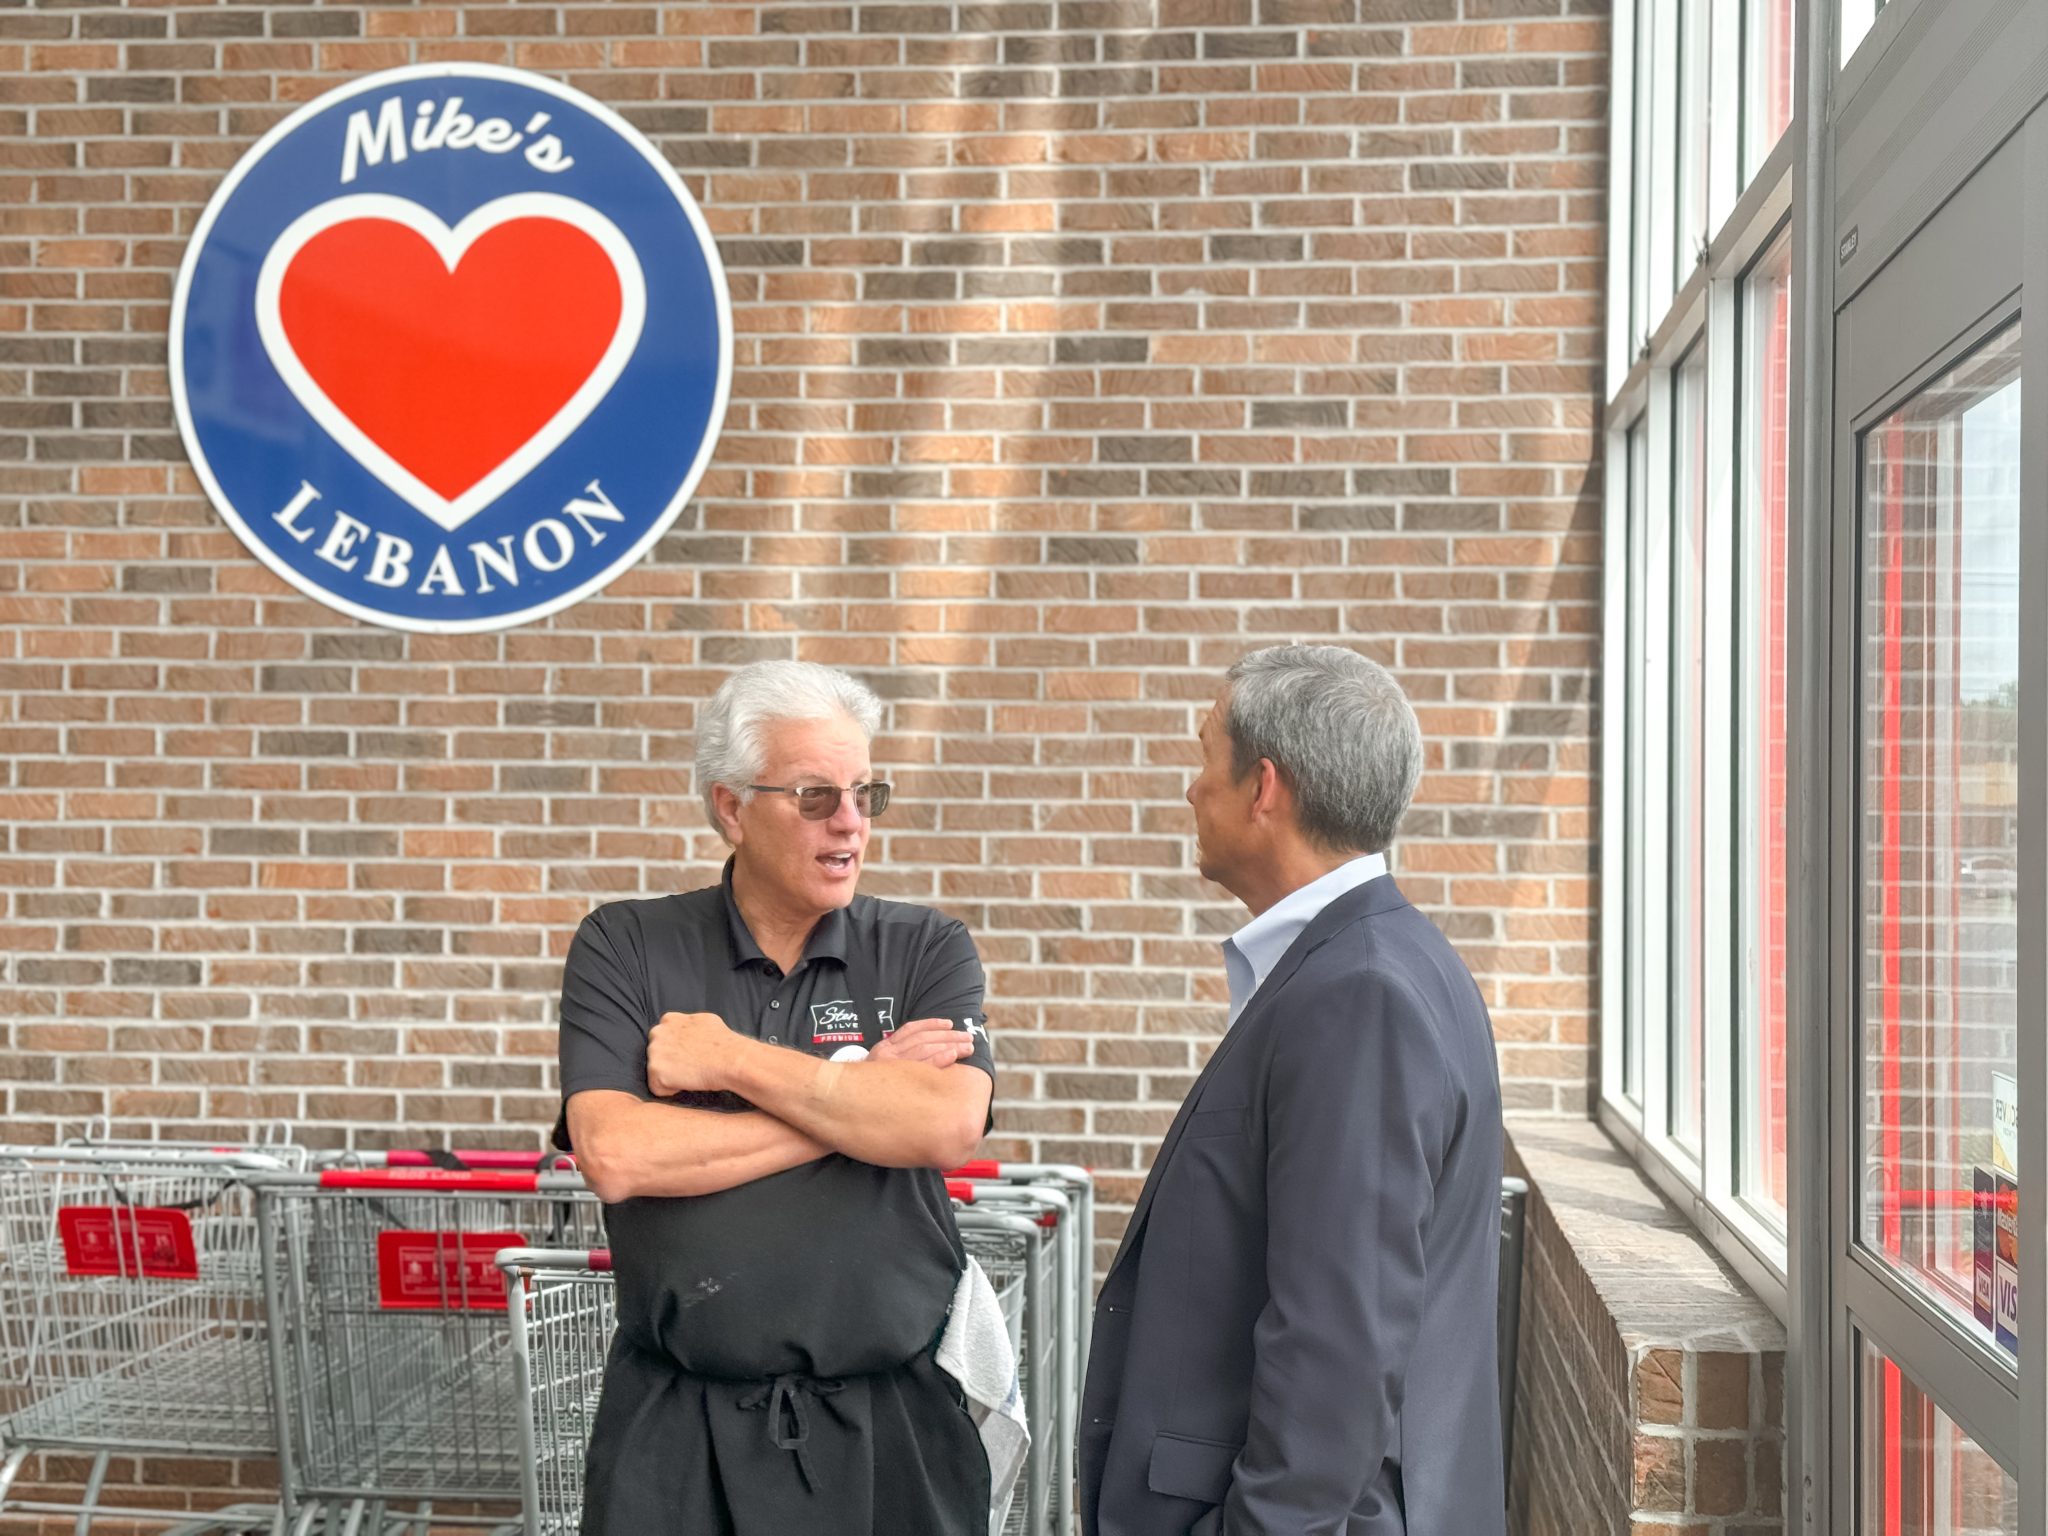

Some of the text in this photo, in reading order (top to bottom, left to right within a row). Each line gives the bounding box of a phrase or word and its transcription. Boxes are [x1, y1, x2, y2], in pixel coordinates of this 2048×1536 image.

[341, 97, 575, 184] Mike's
[272, 480, 626, 596] LEBANON
[827, 1022, 859, 1030] SILVE
[1999, 1275, 2018, 1323] VIS
